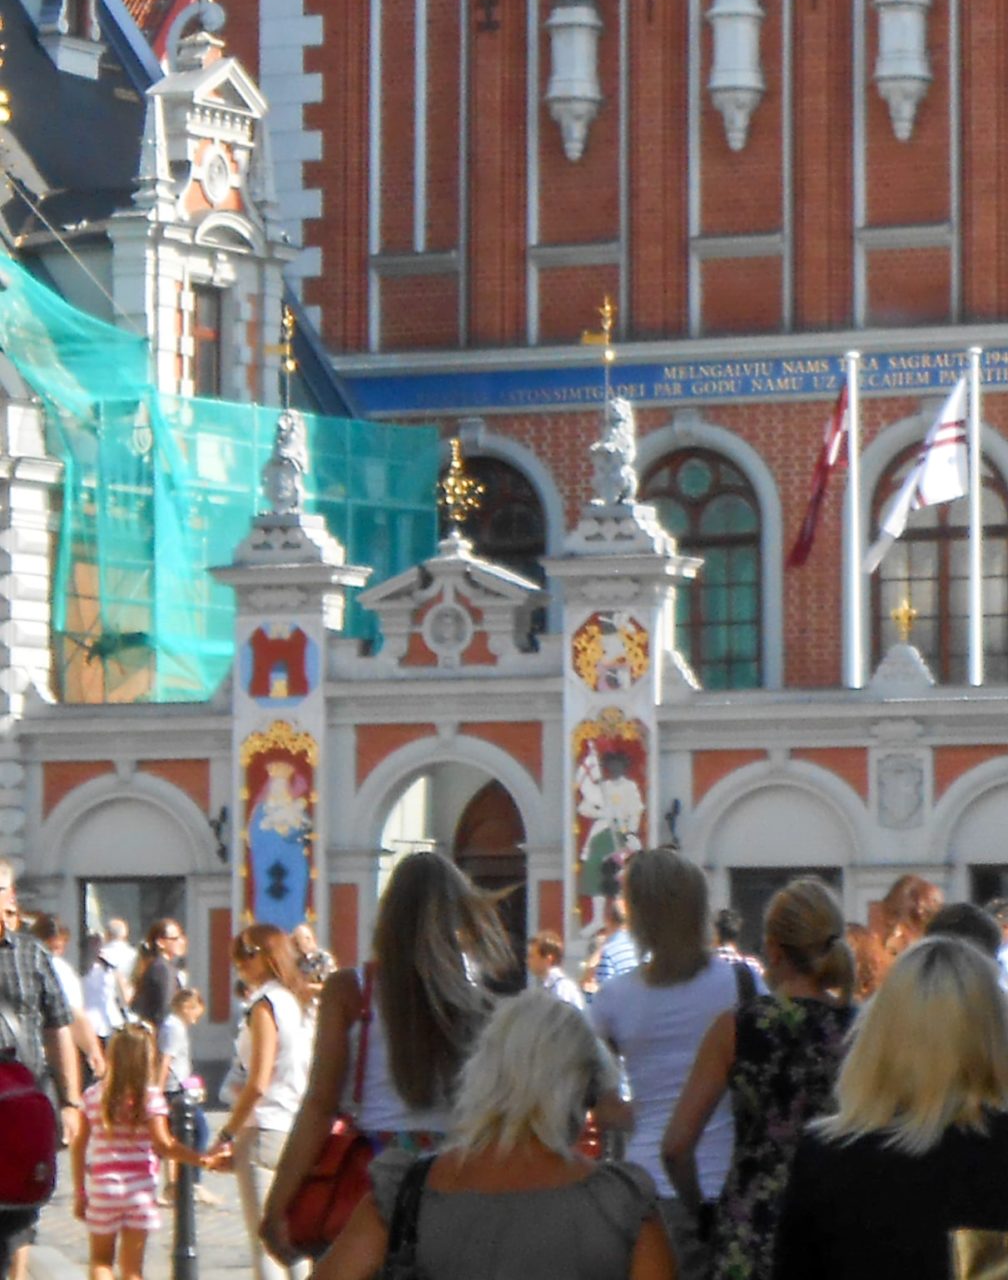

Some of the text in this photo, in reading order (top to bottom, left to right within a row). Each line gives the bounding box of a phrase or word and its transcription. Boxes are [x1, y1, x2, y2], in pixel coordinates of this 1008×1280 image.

[782, 358, 829, 375] NAMS
[888, 351, 969, 370] SAGRAUT
[654, 382, 683, 397] PAR
[751, 375, 803, 392] NAMU
[814, 374, 836, 389] UZ
